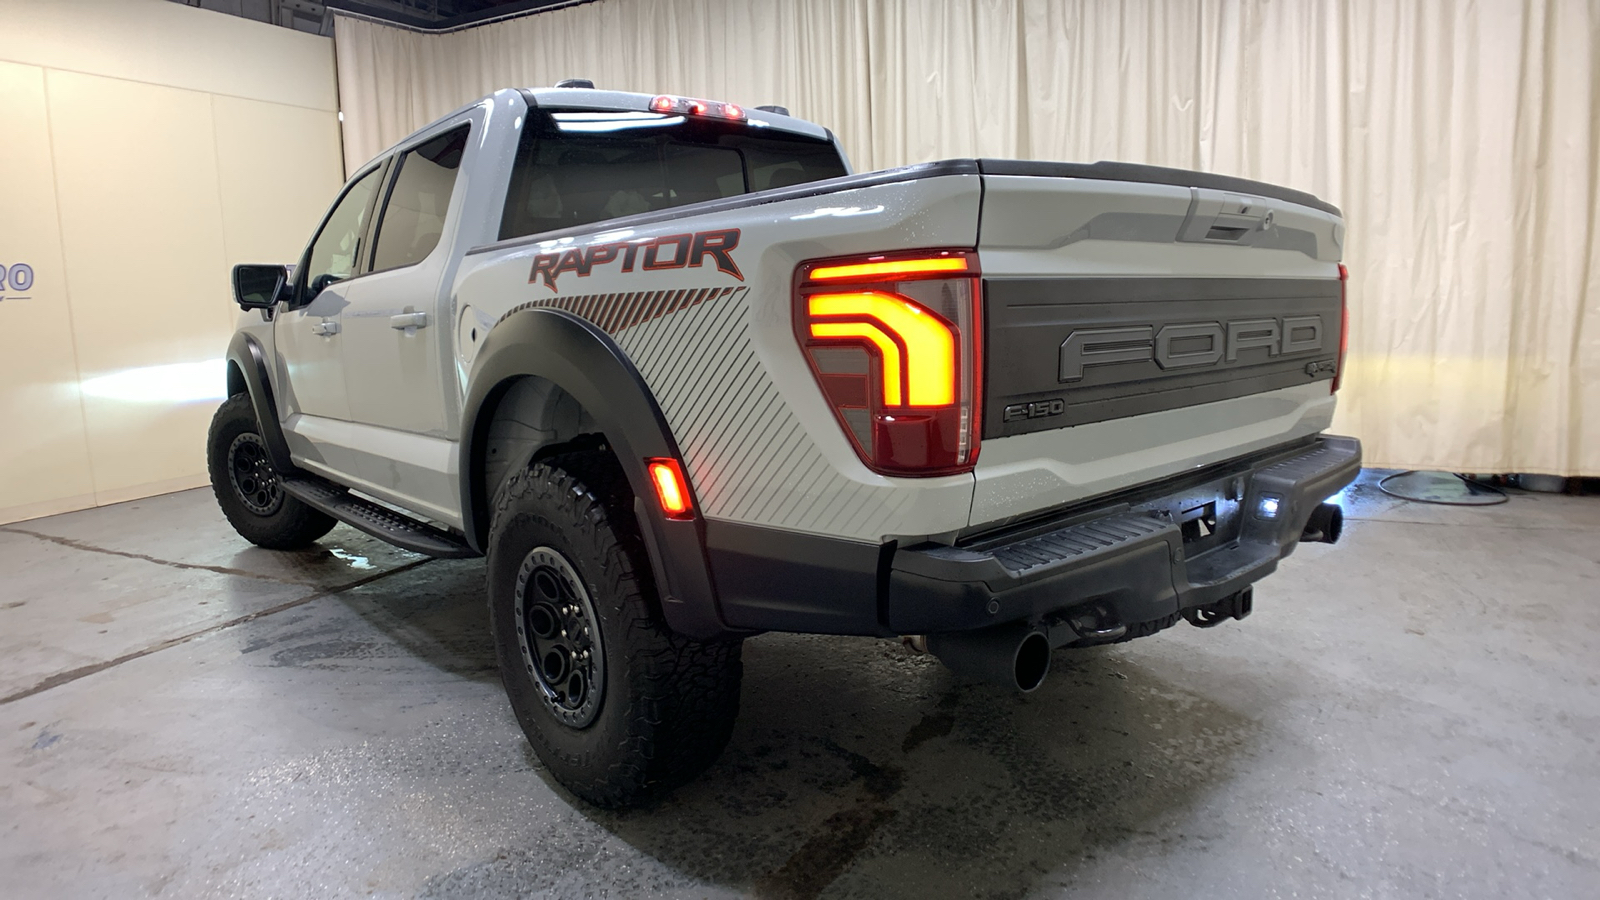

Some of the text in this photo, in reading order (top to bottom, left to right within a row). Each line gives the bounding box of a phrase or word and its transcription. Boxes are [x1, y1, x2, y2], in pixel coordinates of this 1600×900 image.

[0, 263, 34, 291] O
[528, 228, 744, 294] RAPTOR
[1059, 314, 1323, 383] FORD
[1003, 398, 1064, 423] F-150
